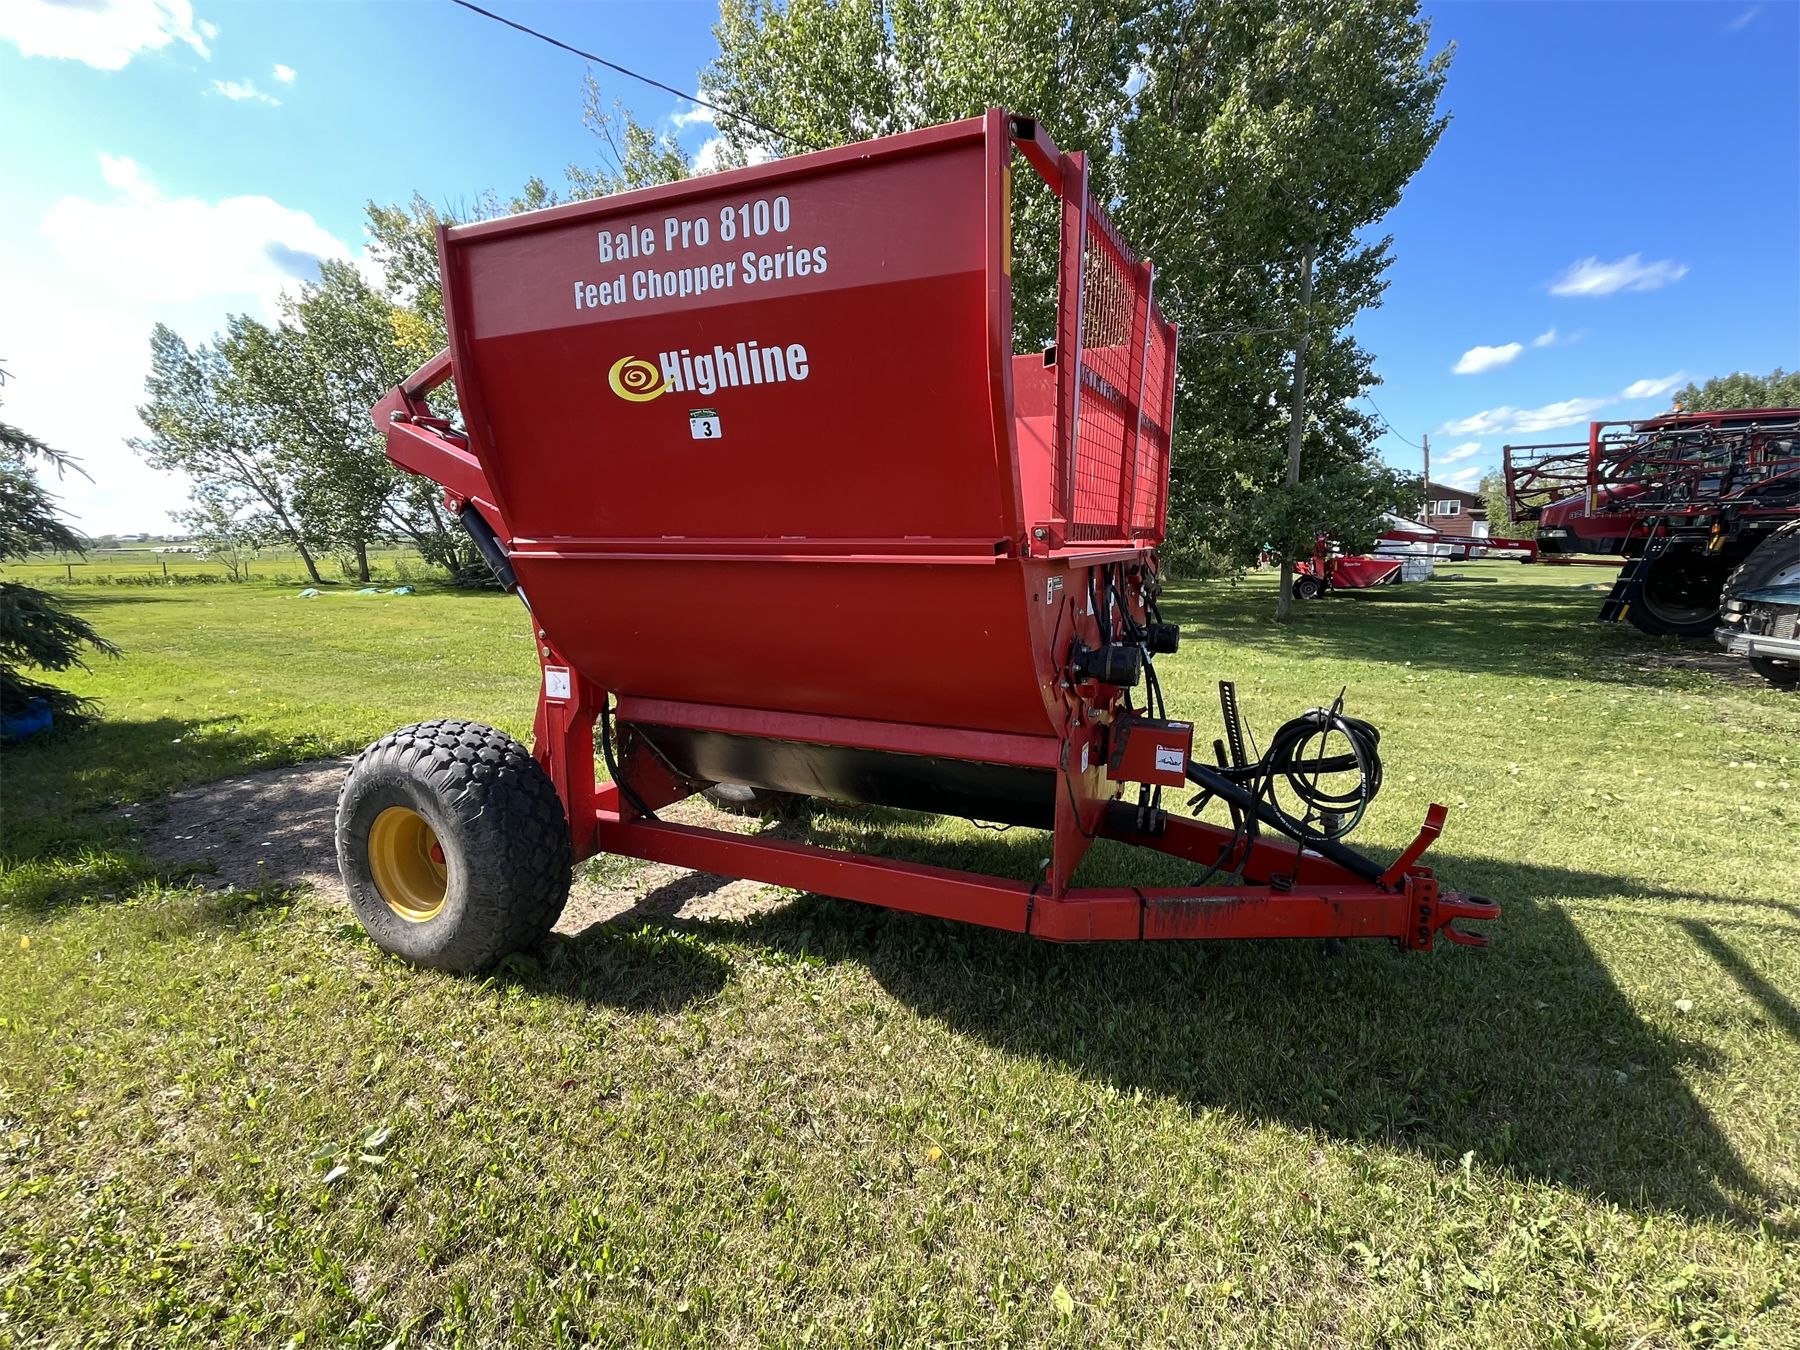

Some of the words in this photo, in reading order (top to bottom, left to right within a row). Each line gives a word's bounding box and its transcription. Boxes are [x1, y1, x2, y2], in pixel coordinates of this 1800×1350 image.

[598, 225, 656, 263] Bale
[664, 216, 710, 252] Pro
[720, 196, 790, 242] 8100
[574, 274, 627, 310] Feed
[632, 261, 736, 301] Chopper
[741, 245, 828, 285] Series
[658, 340, 810, 395] Highline
[703, 421, 713, 437] 3
